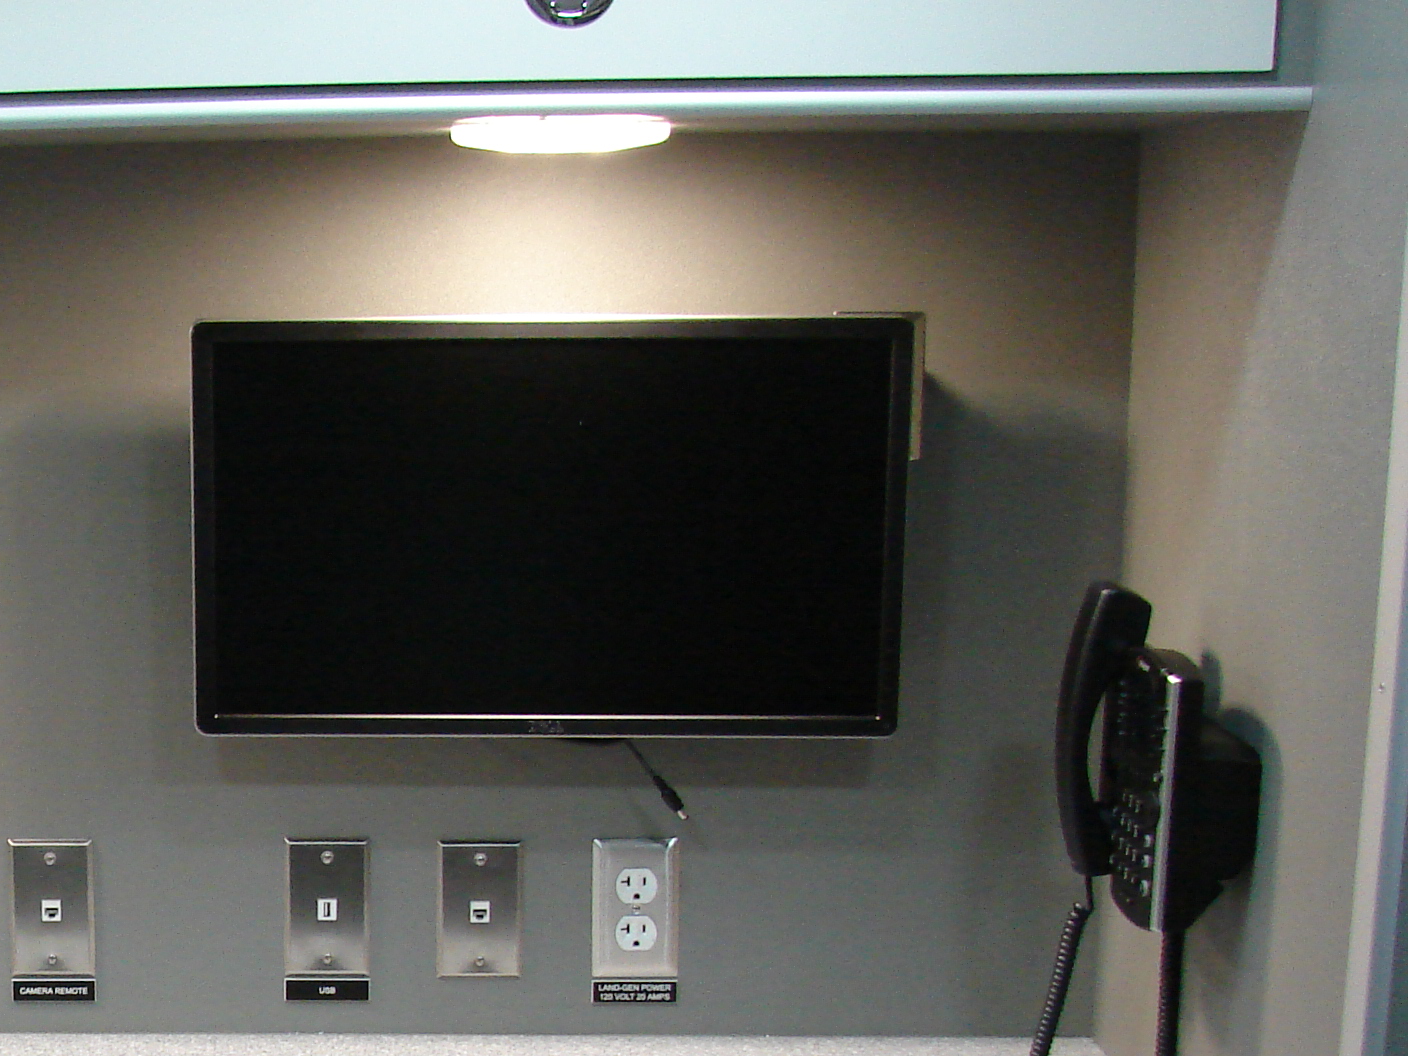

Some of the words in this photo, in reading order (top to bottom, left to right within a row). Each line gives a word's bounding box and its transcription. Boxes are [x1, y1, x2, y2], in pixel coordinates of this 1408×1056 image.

[19, 986, 54, 995] CAMERA
[54, 986, 89, 995] REMOTE
[318, 985, 337, 995] USB
[641, 983, 672, 992] POWER
[614, 992, 635, 1001] VOLT
[647, 992, 671, 1001] AMPS
